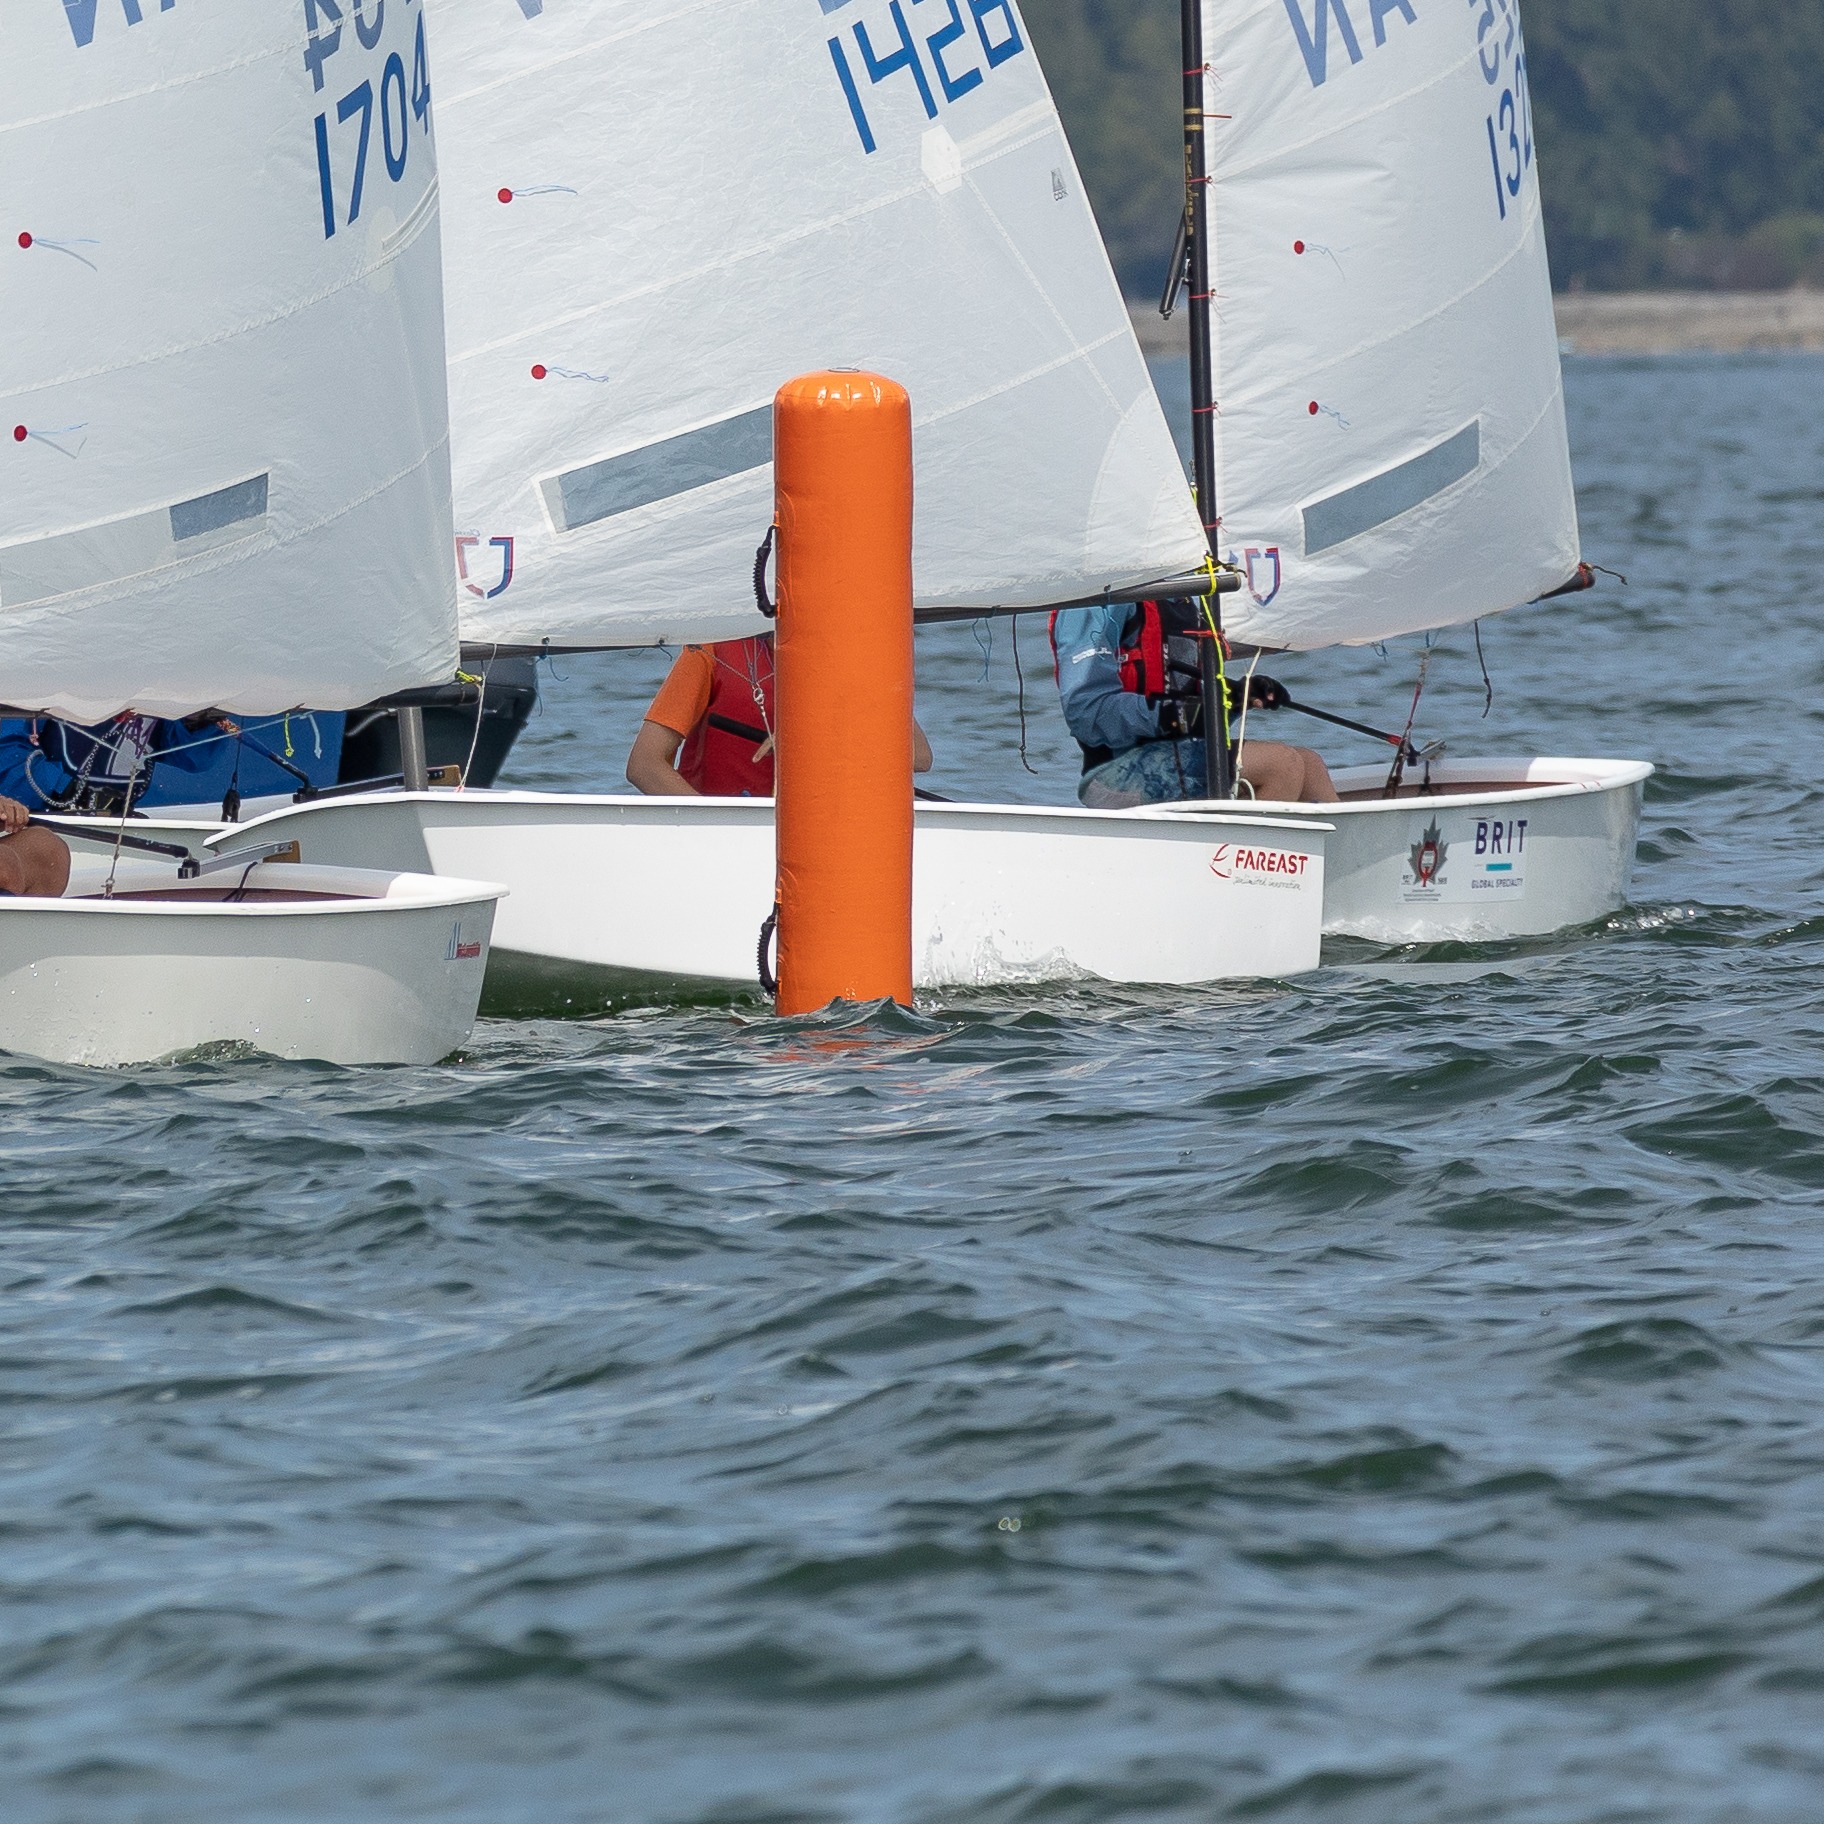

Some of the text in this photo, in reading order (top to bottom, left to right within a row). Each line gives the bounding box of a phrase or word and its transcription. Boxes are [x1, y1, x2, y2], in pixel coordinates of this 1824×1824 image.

[313, 9, 431, 240] 1704
[1486, 52, 1532, 222] 132
[1235, 849, 1309, 875] FAREAST
[1475, 819, 1528, 855] BRIT
